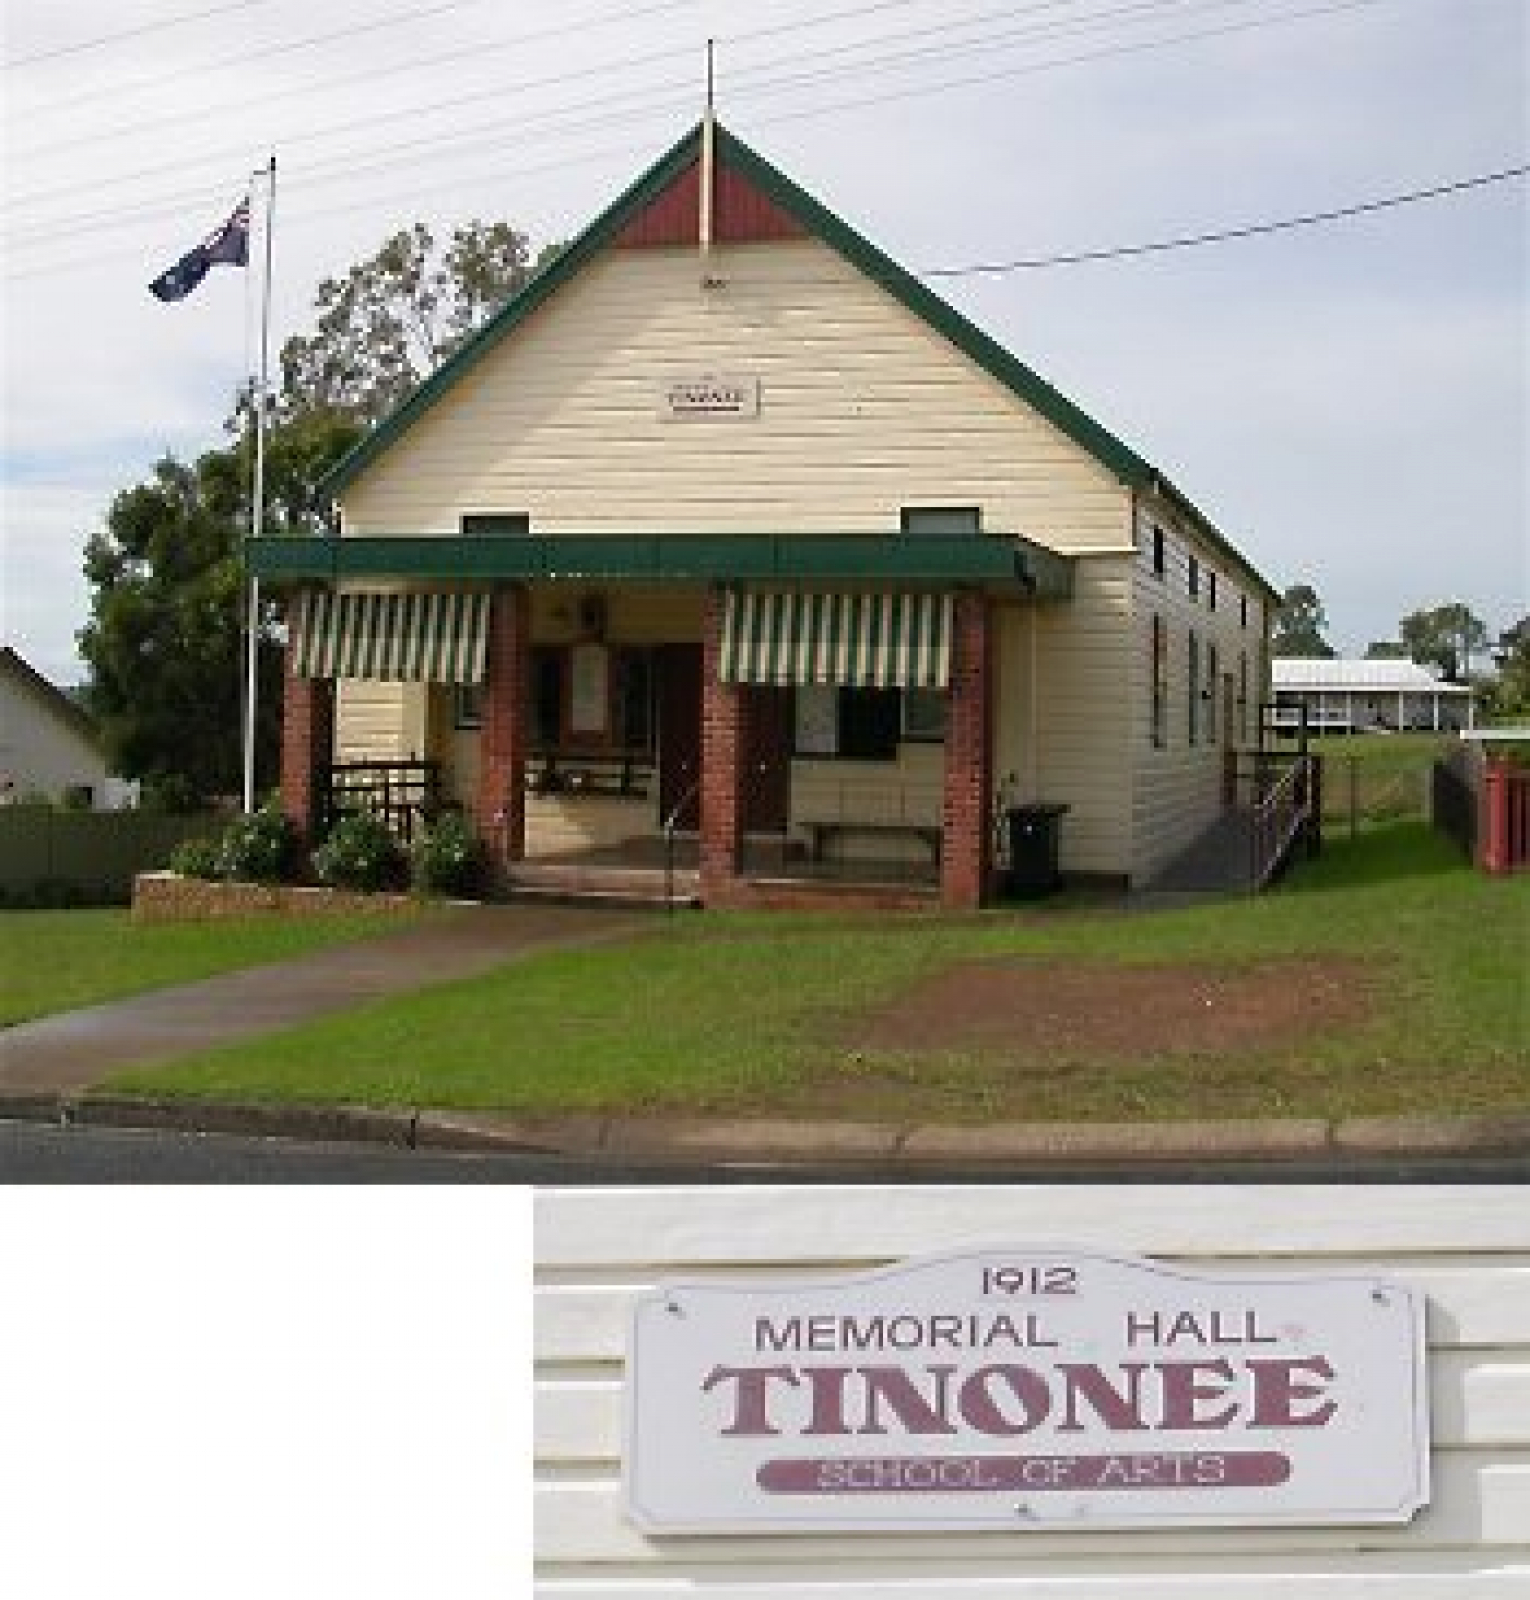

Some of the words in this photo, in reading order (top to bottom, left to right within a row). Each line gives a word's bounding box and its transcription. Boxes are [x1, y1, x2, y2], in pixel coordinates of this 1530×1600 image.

[981, 1267, 1077, 1295] 1912
[755, 1315, 1058, 1352] MEMORIAL
[1126, 1311, 1277, 1347] HALL
[701, 1356, 1337, 1435] TINONEE
[817, 1460, 998, 1488] SCHOOL
[1022, 1458, 1076, 1485] OF
[1100, 1456, 1226, 1484] ARTS
